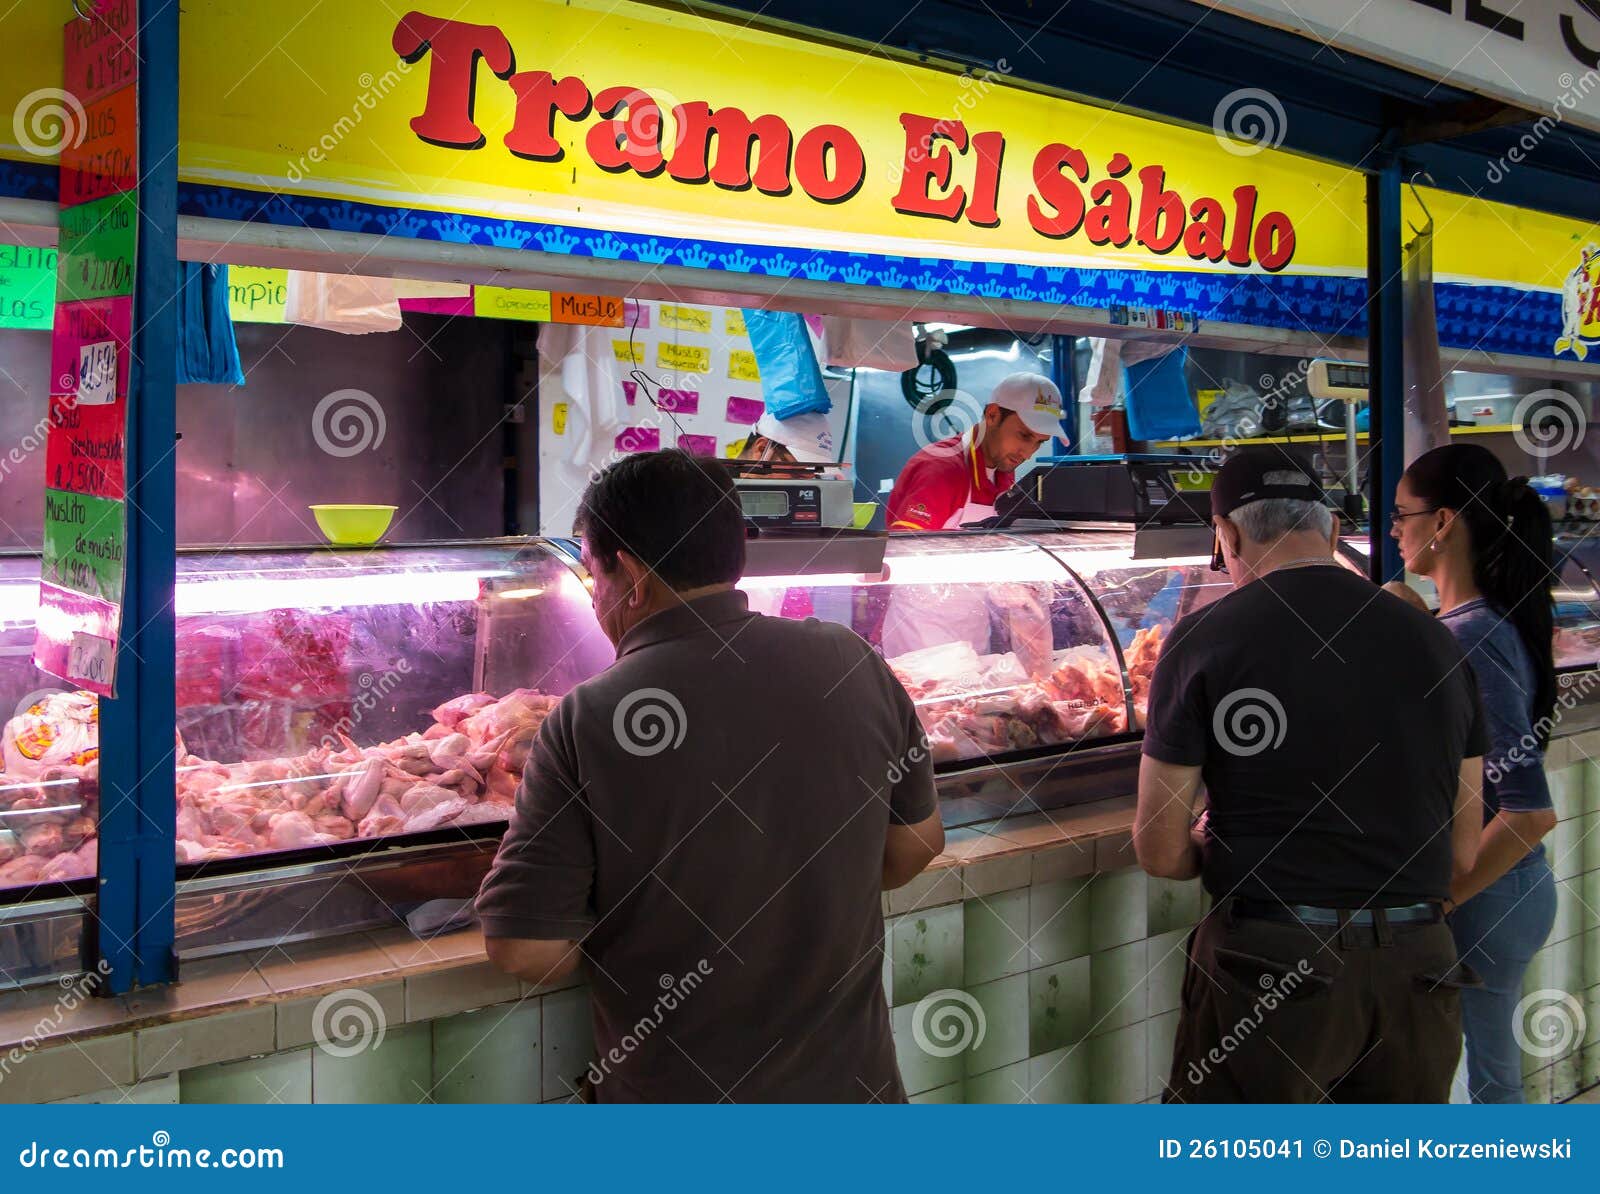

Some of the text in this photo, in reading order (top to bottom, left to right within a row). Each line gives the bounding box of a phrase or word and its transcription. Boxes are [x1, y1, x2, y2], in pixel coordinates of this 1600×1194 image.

[392, 10, 1297, 273] Tramo El Sábalo
